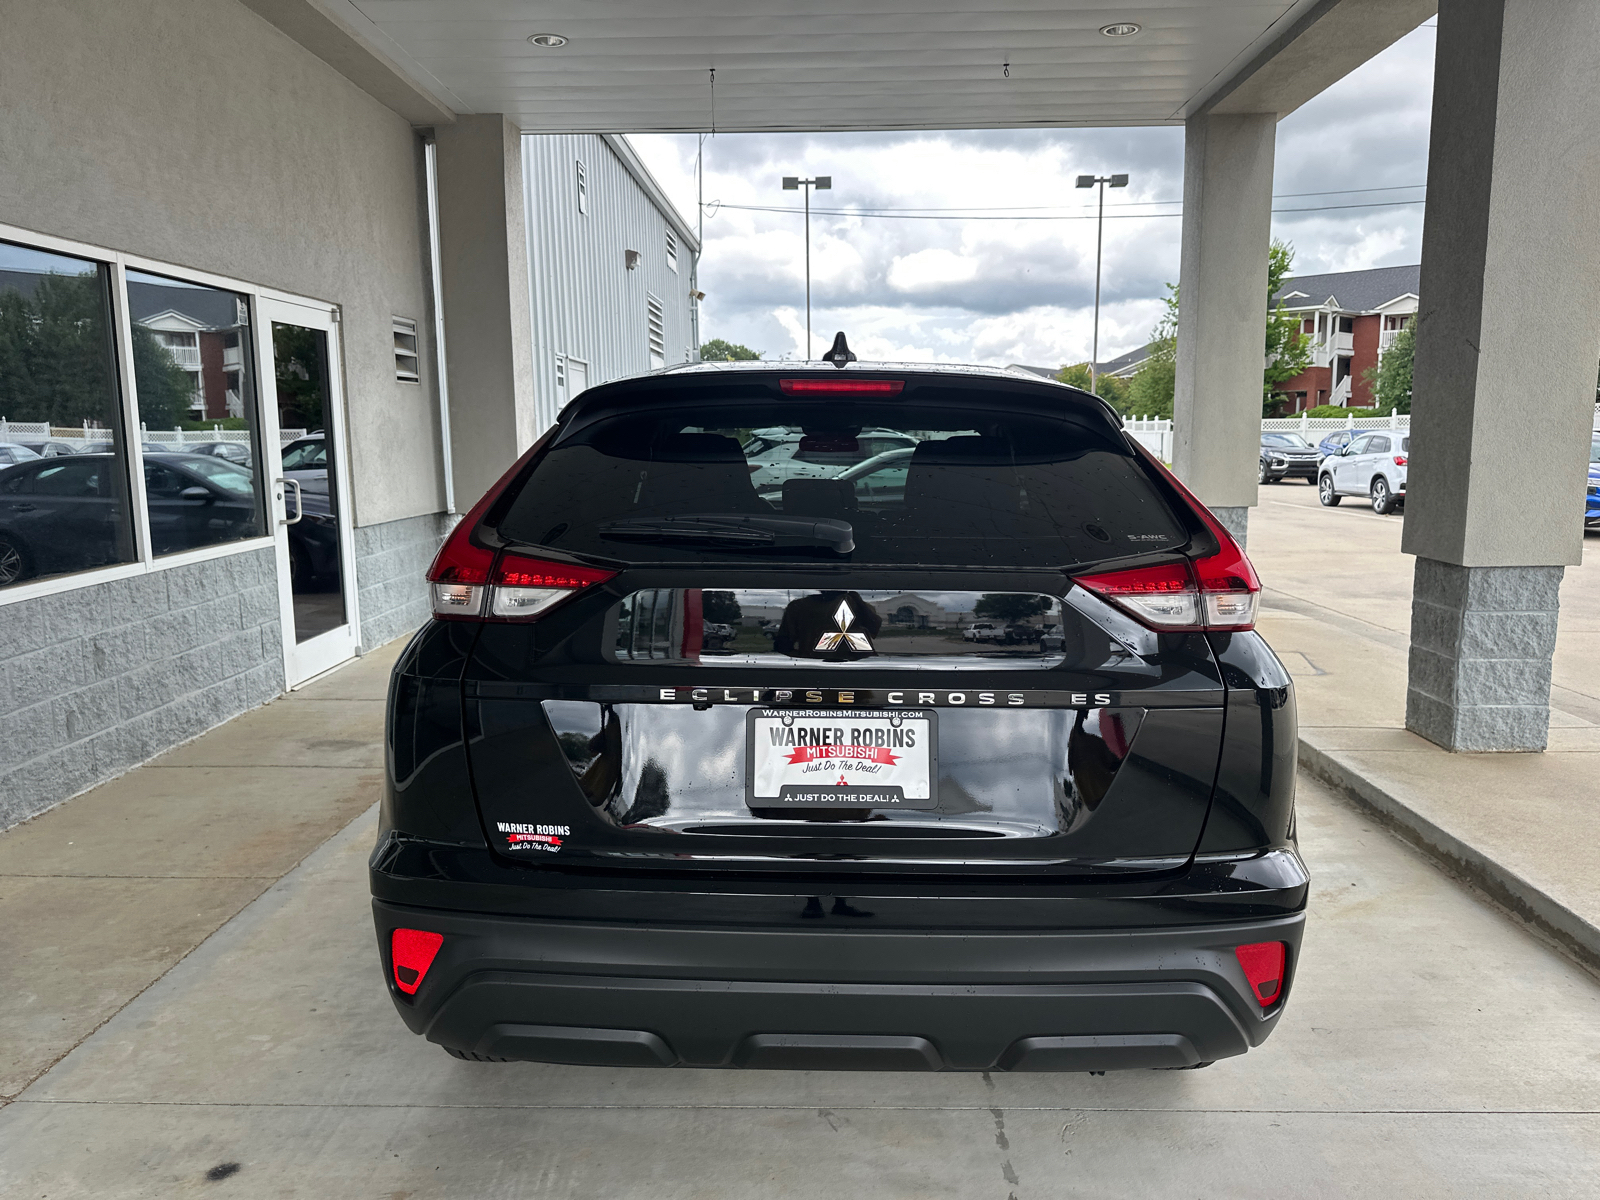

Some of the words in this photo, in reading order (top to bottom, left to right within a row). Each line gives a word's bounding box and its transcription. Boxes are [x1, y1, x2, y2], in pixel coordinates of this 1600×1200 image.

[659, 688, 855, 703] ECLIPSE
[887, 692, 1025, 705] CROSS
[1071, 693, 1111, 705] ES
[769, 727, 845, 747] WARNER
[851, 728, 916, 748] ROBINS
[806, 747, 878, 759] MITSUBISHI
[802, 761, 823, 773] Just
[824, 760, 836, 770] Do
[838, 760, 853, 771] The
[855, 761, 882, 774] Deal!
[794, 793, 820, 801] JUST
[822, 793, 835, 801] DO
[839, 794, 857, 802] THE
[858, 794, 889, 802] DEAL!
[496, 822, 535, 834] WARNER
[536, 824, 571, 836] ROBINS
[516, 834, 553, 842] MITSUBISHI
[508, 843, 522, 851] Just
[531, 842, 542, 850] The
[542, 843, 561, 853] Deal!
